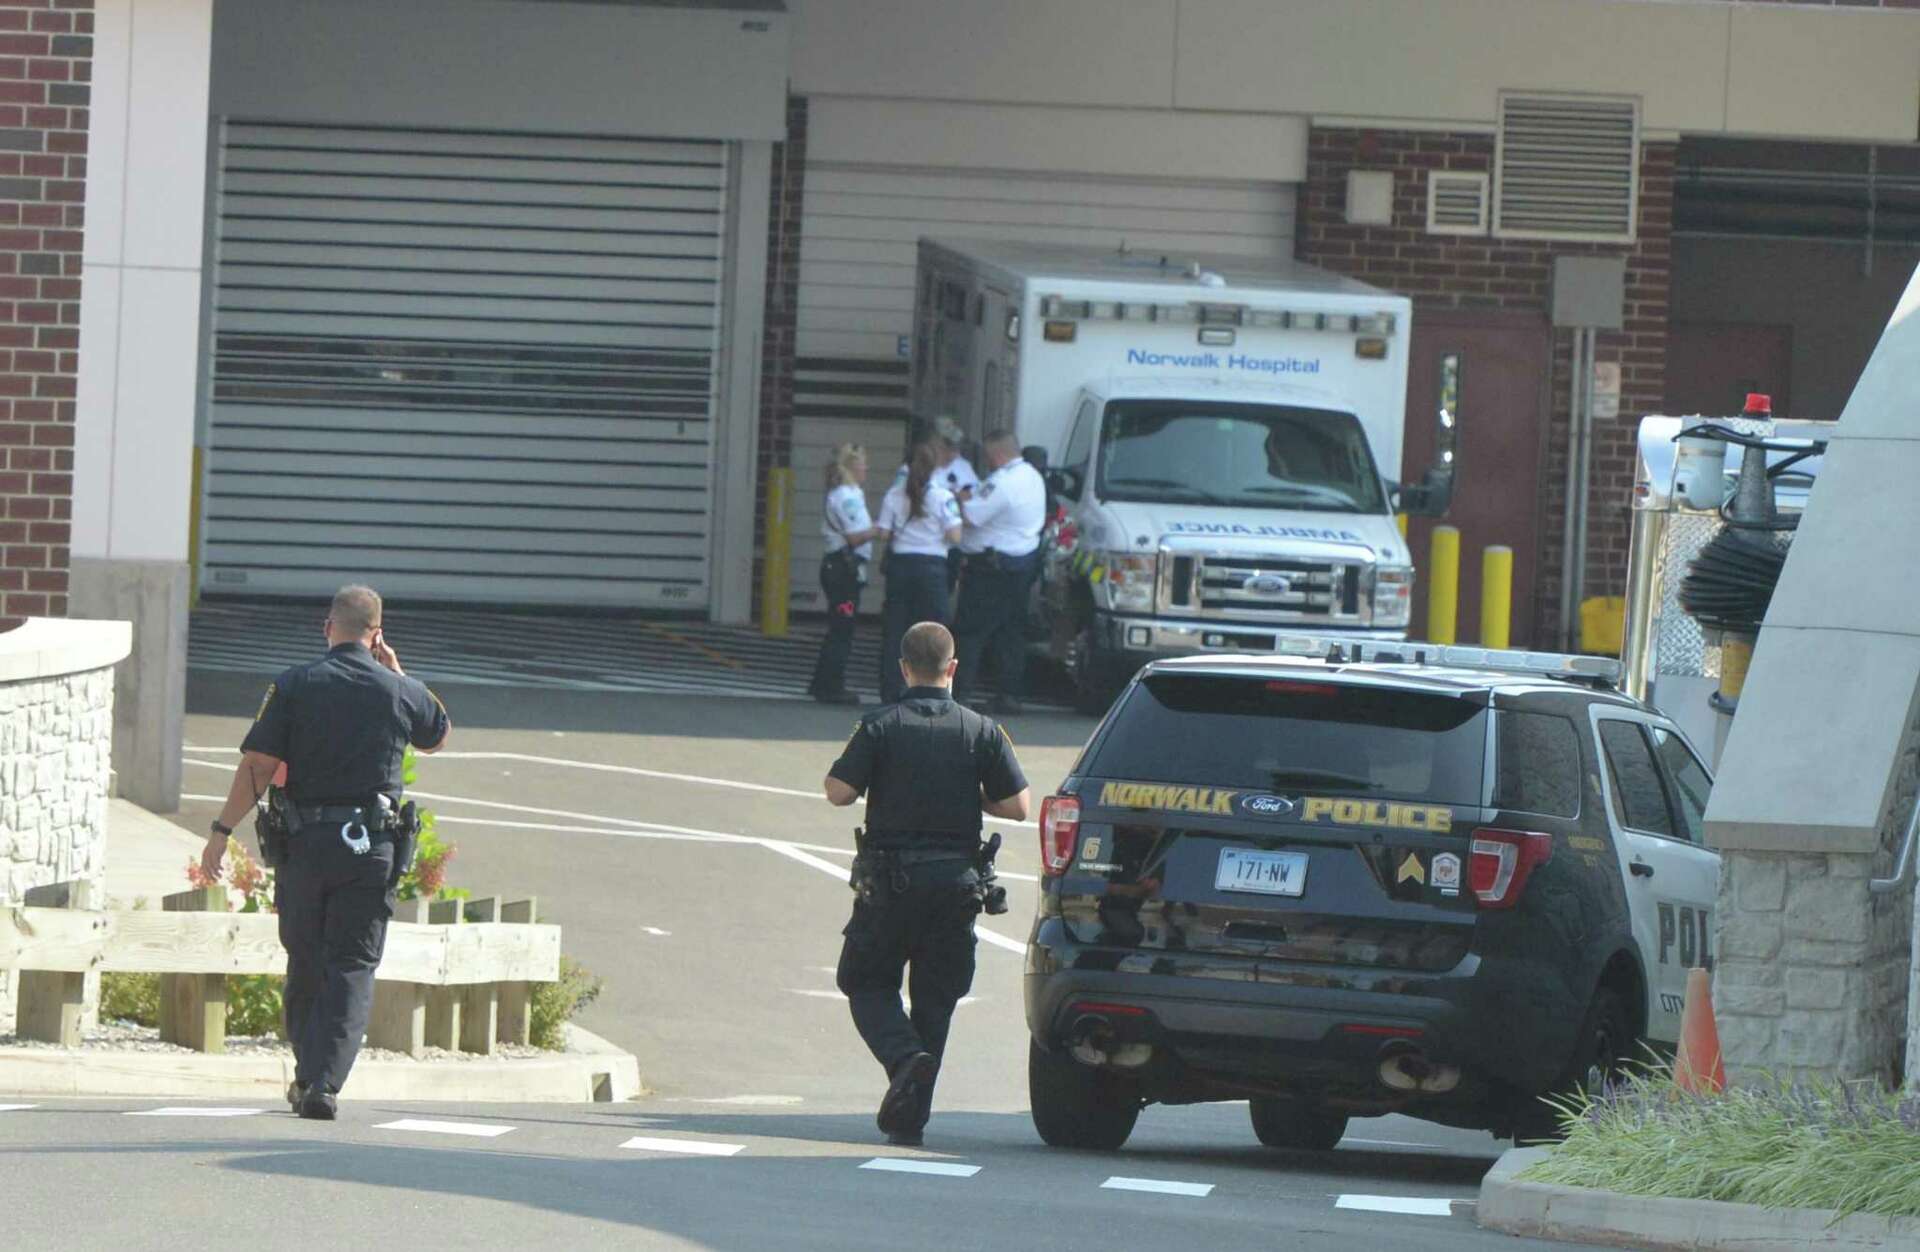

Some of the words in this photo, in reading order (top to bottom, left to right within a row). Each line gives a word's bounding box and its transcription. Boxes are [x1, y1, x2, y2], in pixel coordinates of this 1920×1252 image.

[1127, 348, 1220, 369] Norwalk
[1228, 353, 1321, 374] Hospital
[1098, 781, 1238, 817] NORWALK
[1300, 796, 1453, 833] POLICE
